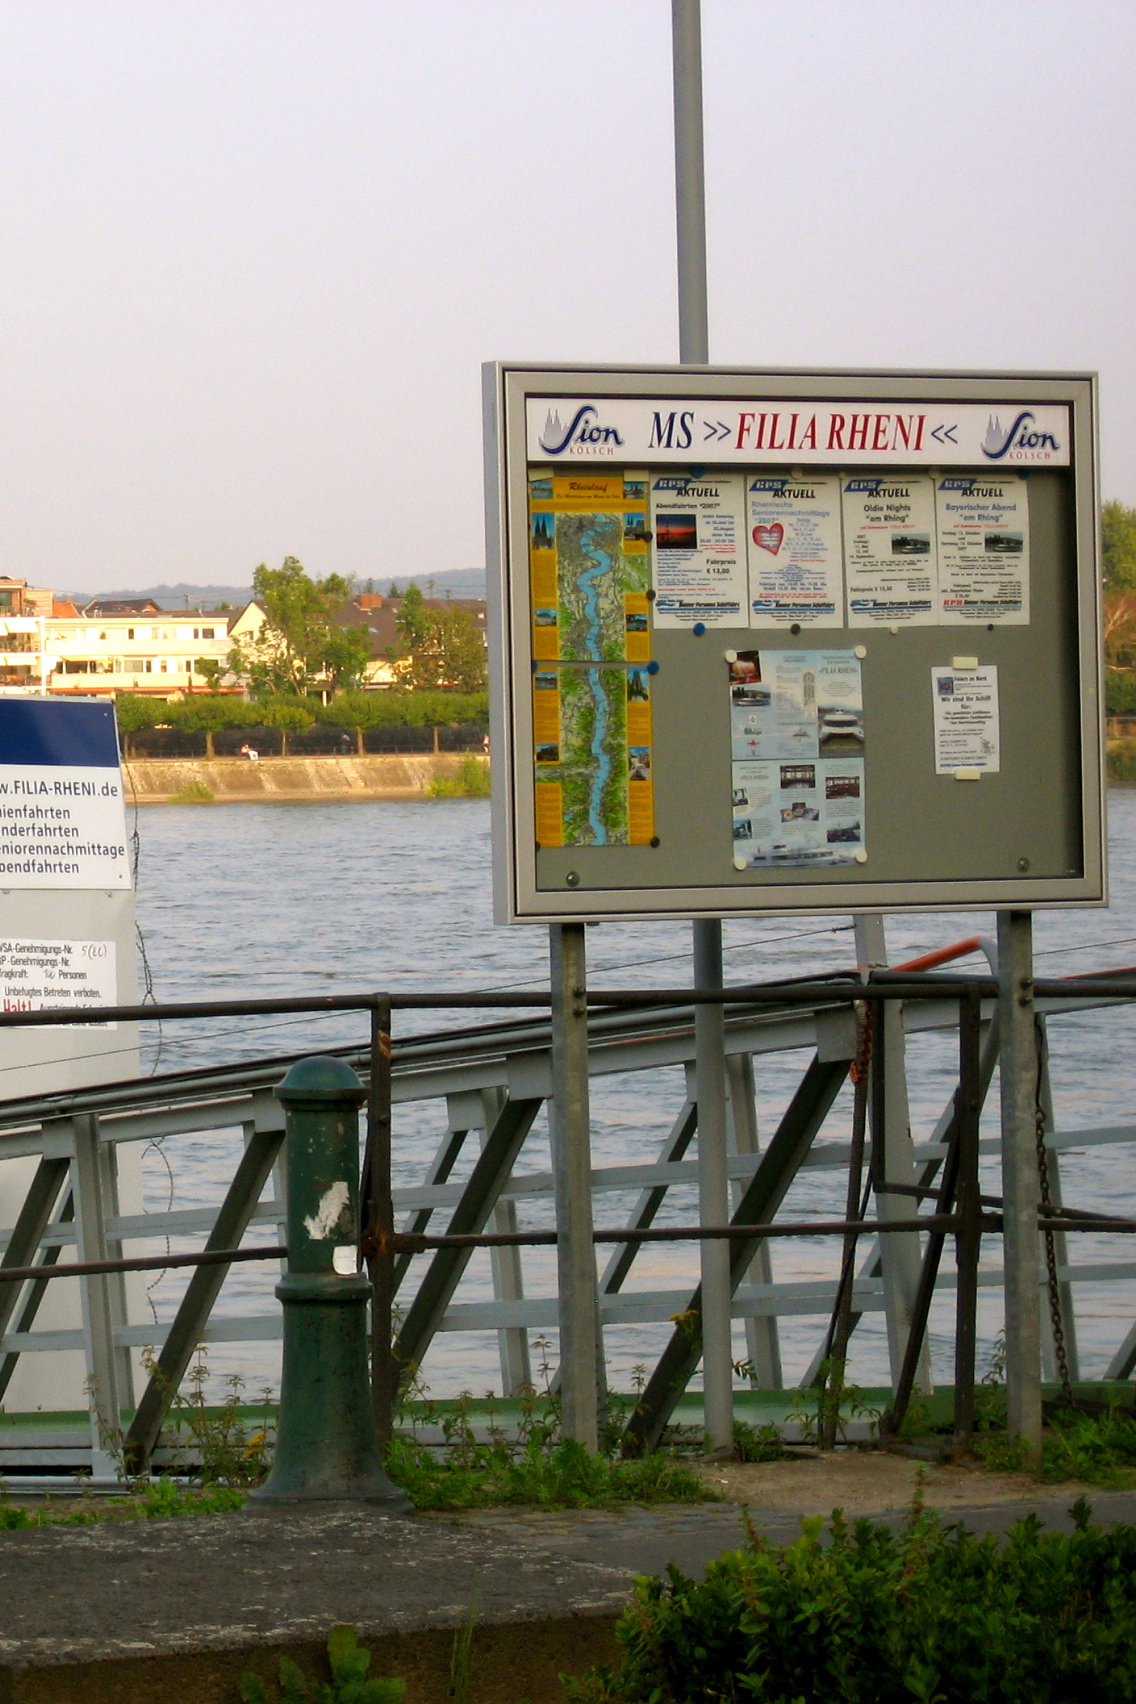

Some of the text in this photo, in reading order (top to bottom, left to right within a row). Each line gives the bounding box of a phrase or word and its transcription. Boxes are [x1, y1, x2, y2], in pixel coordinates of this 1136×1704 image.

[539, 404, 625, 456] Sion
[648, 411, 695, 449] MS
[734, 412, 817, 450] FILIA
[826, 413, 926, 451] RHENI
[980, 410, 1060, 461] Sion
[676, 488, 720, 497] AKTUELL
[773, 489, 816, 498] AKTUELL
[868, 489, 910, 498] AKTUELL
[961, 488, 1004, 497] AKTUELL
[886, 504, 911, 513] Nights
[945, 503, 989, 512] Bayerischer
[58, 969, 87, 979] Personen
[5, 986, 101, 998] Unbefugtes Betreten verboten.
